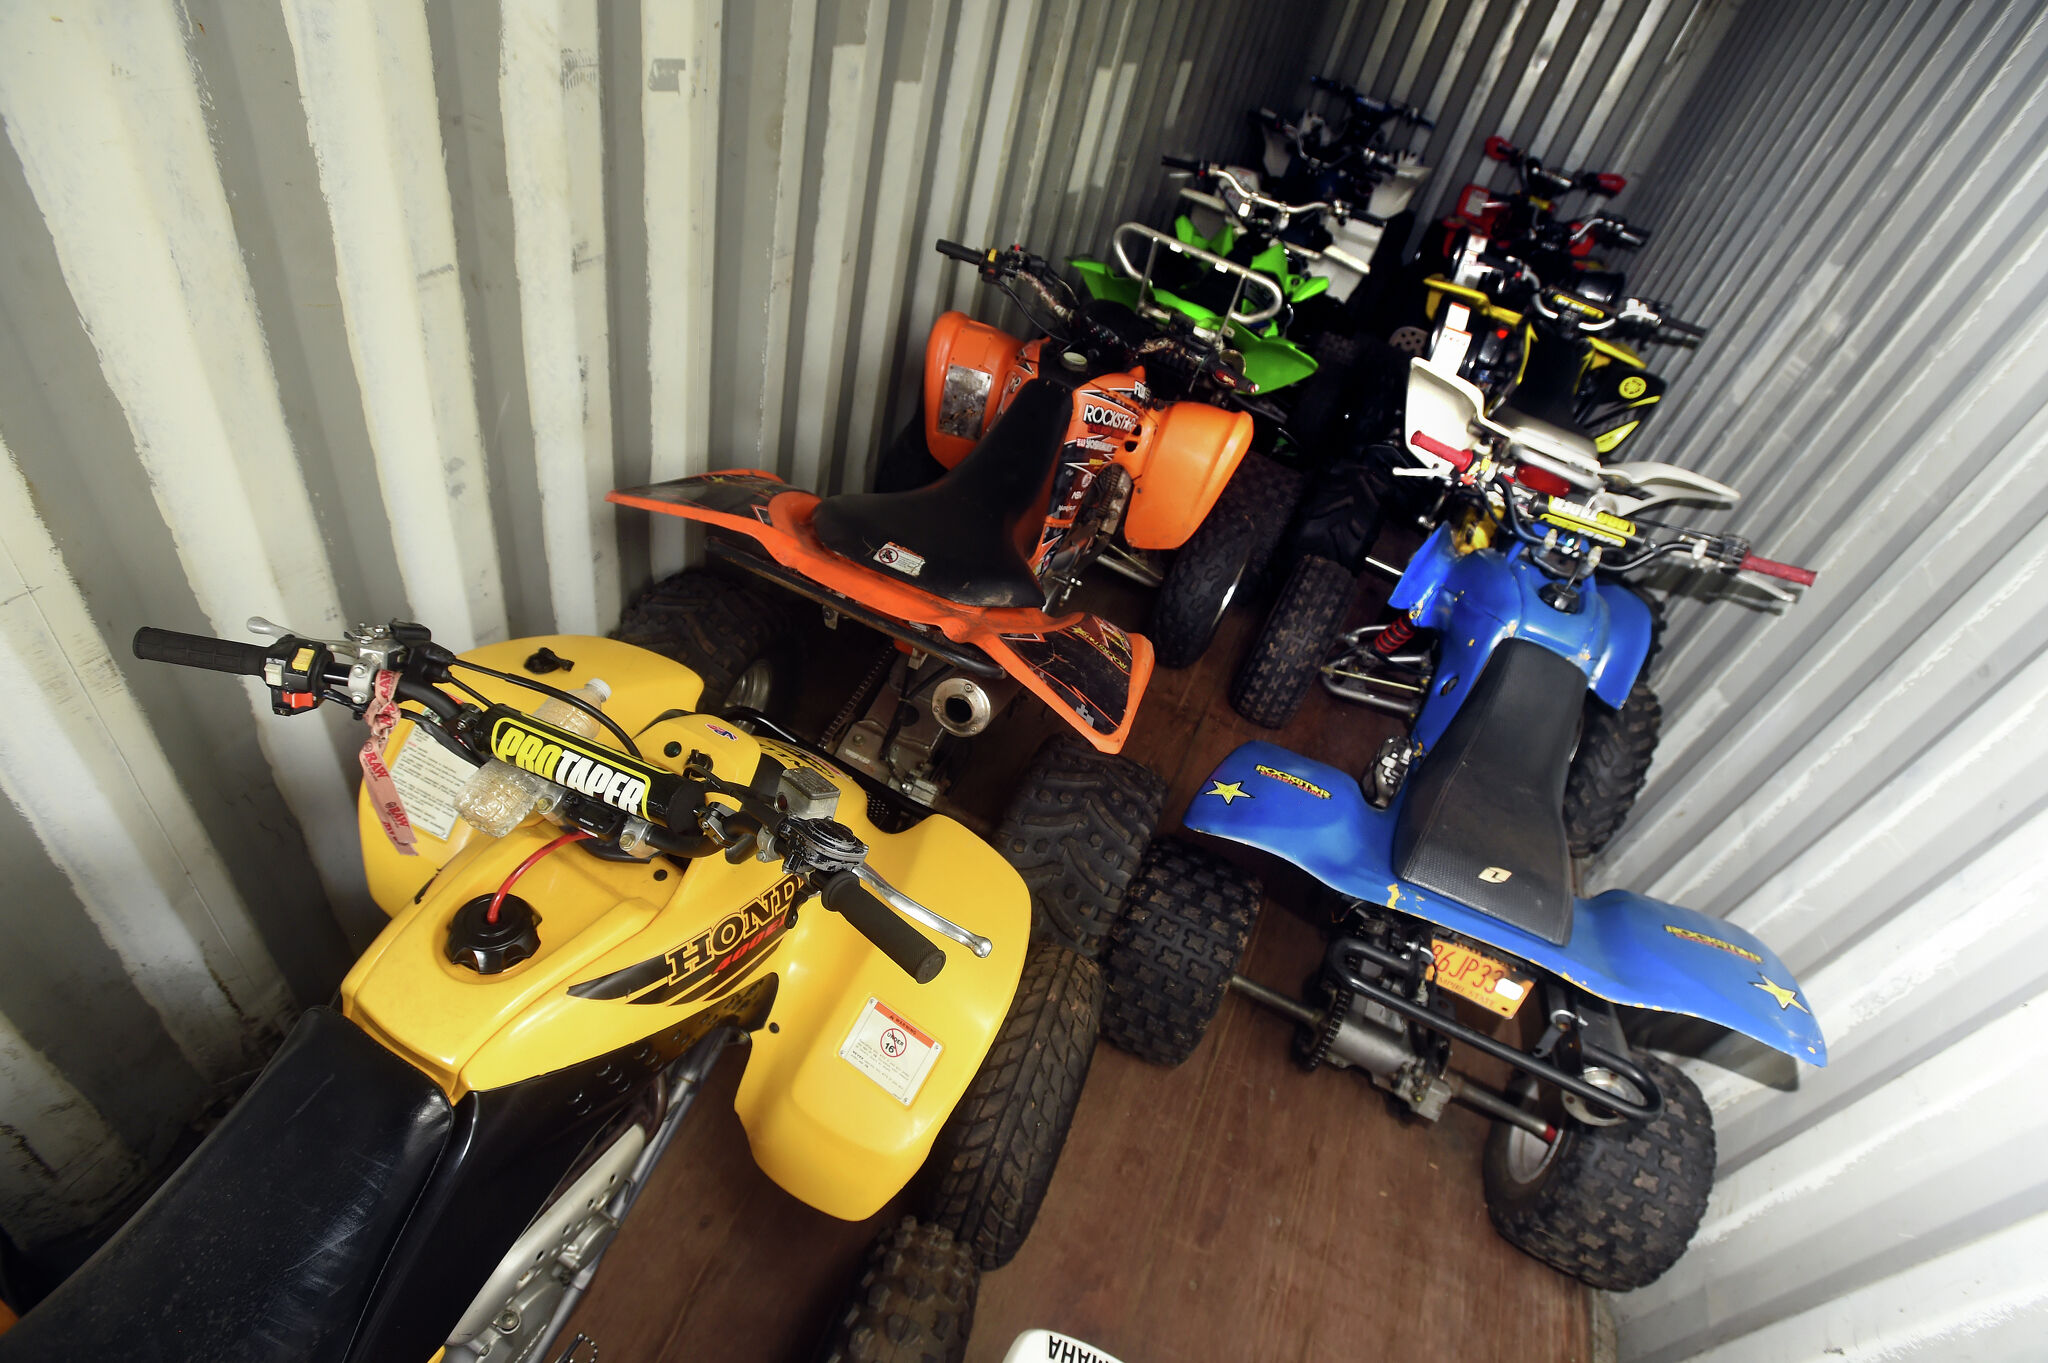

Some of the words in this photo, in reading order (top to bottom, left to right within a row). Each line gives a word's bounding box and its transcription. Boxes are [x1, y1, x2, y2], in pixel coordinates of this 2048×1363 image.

[364, 752, 389, 778] RAW
[497, 726, 646, 815] PROTAPER
[664, 873, 803, 986] HOND
[884, 1042, 895, 1054] 16
[886, 1032, 905, 1047] UNDER
